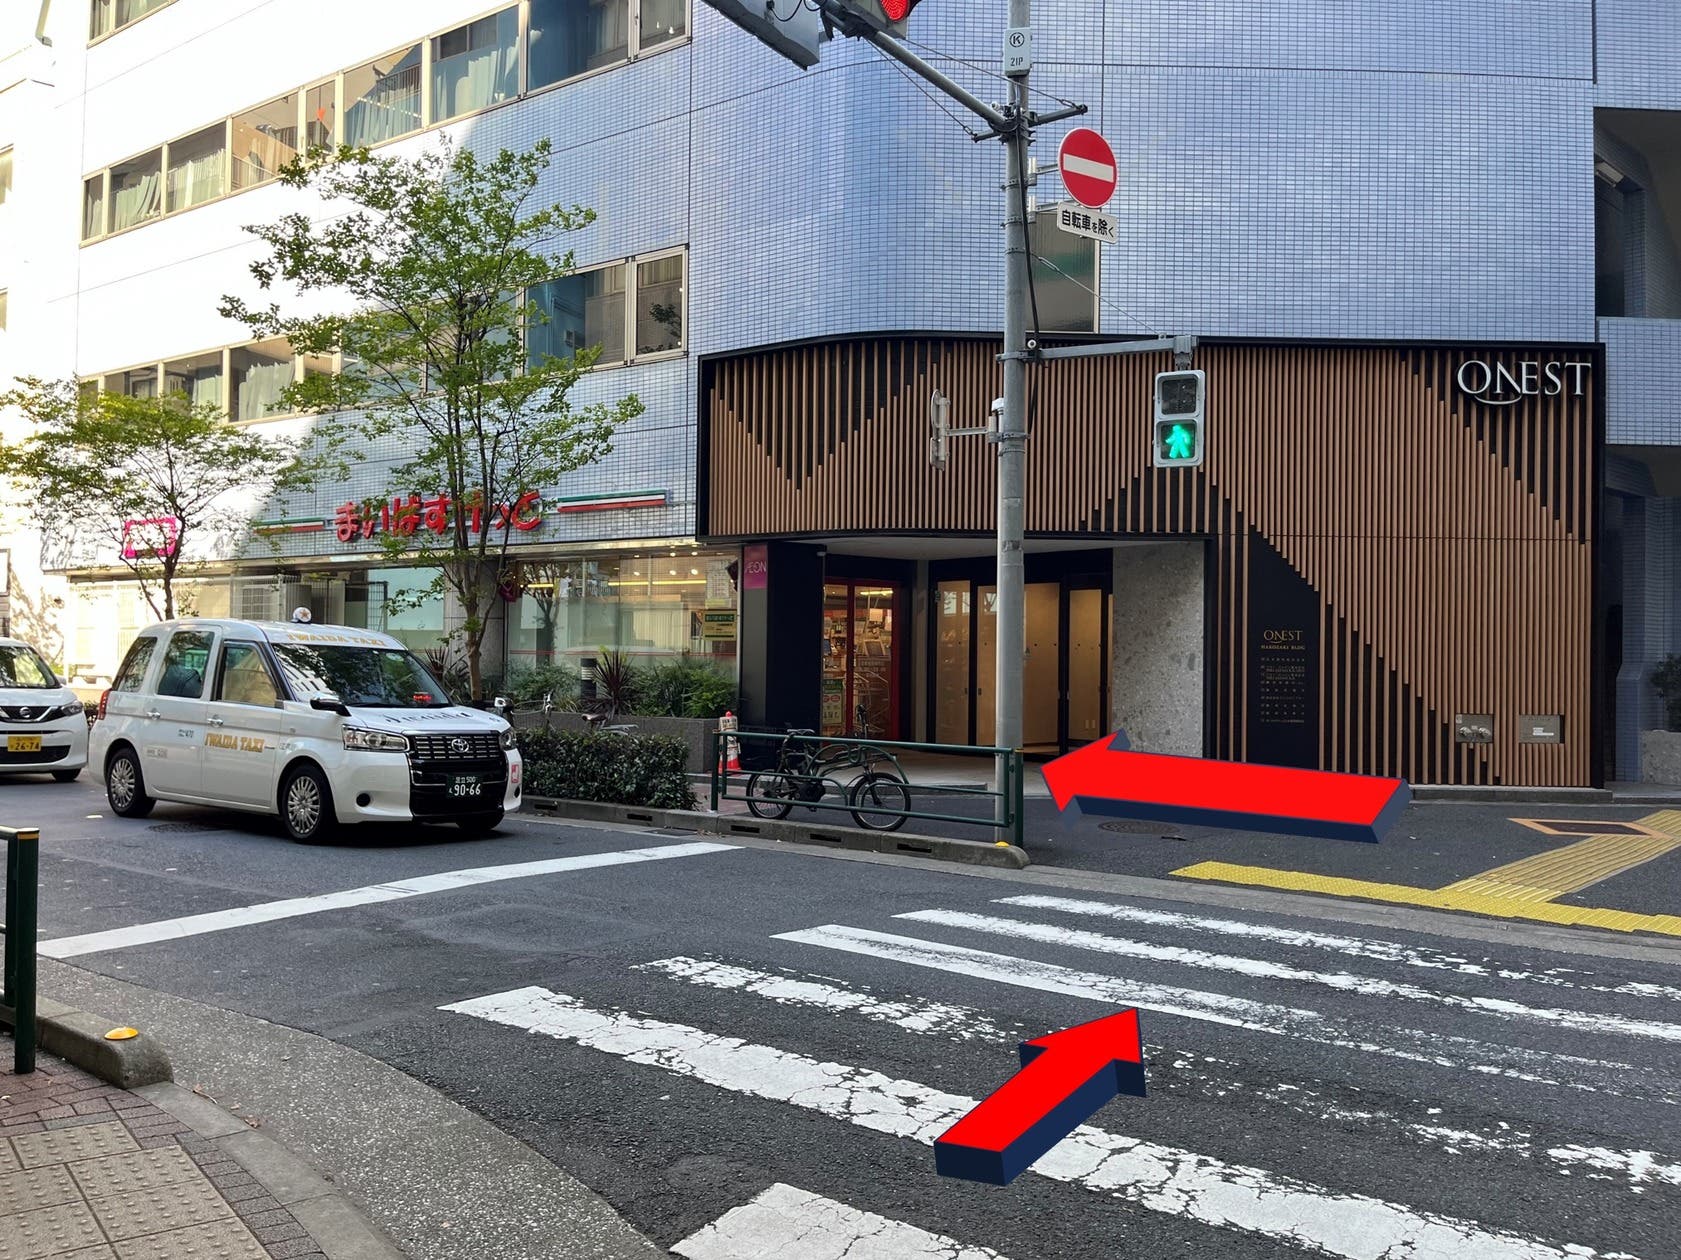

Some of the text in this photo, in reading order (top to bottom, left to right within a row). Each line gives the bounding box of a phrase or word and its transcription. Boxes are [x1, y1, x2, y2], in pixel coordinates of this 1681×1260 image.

[1062, 209, 1119, 238] 自転車を除く
[240, 736, 265, 753] TAXI
[454, 783, 481, 796] 90-66
